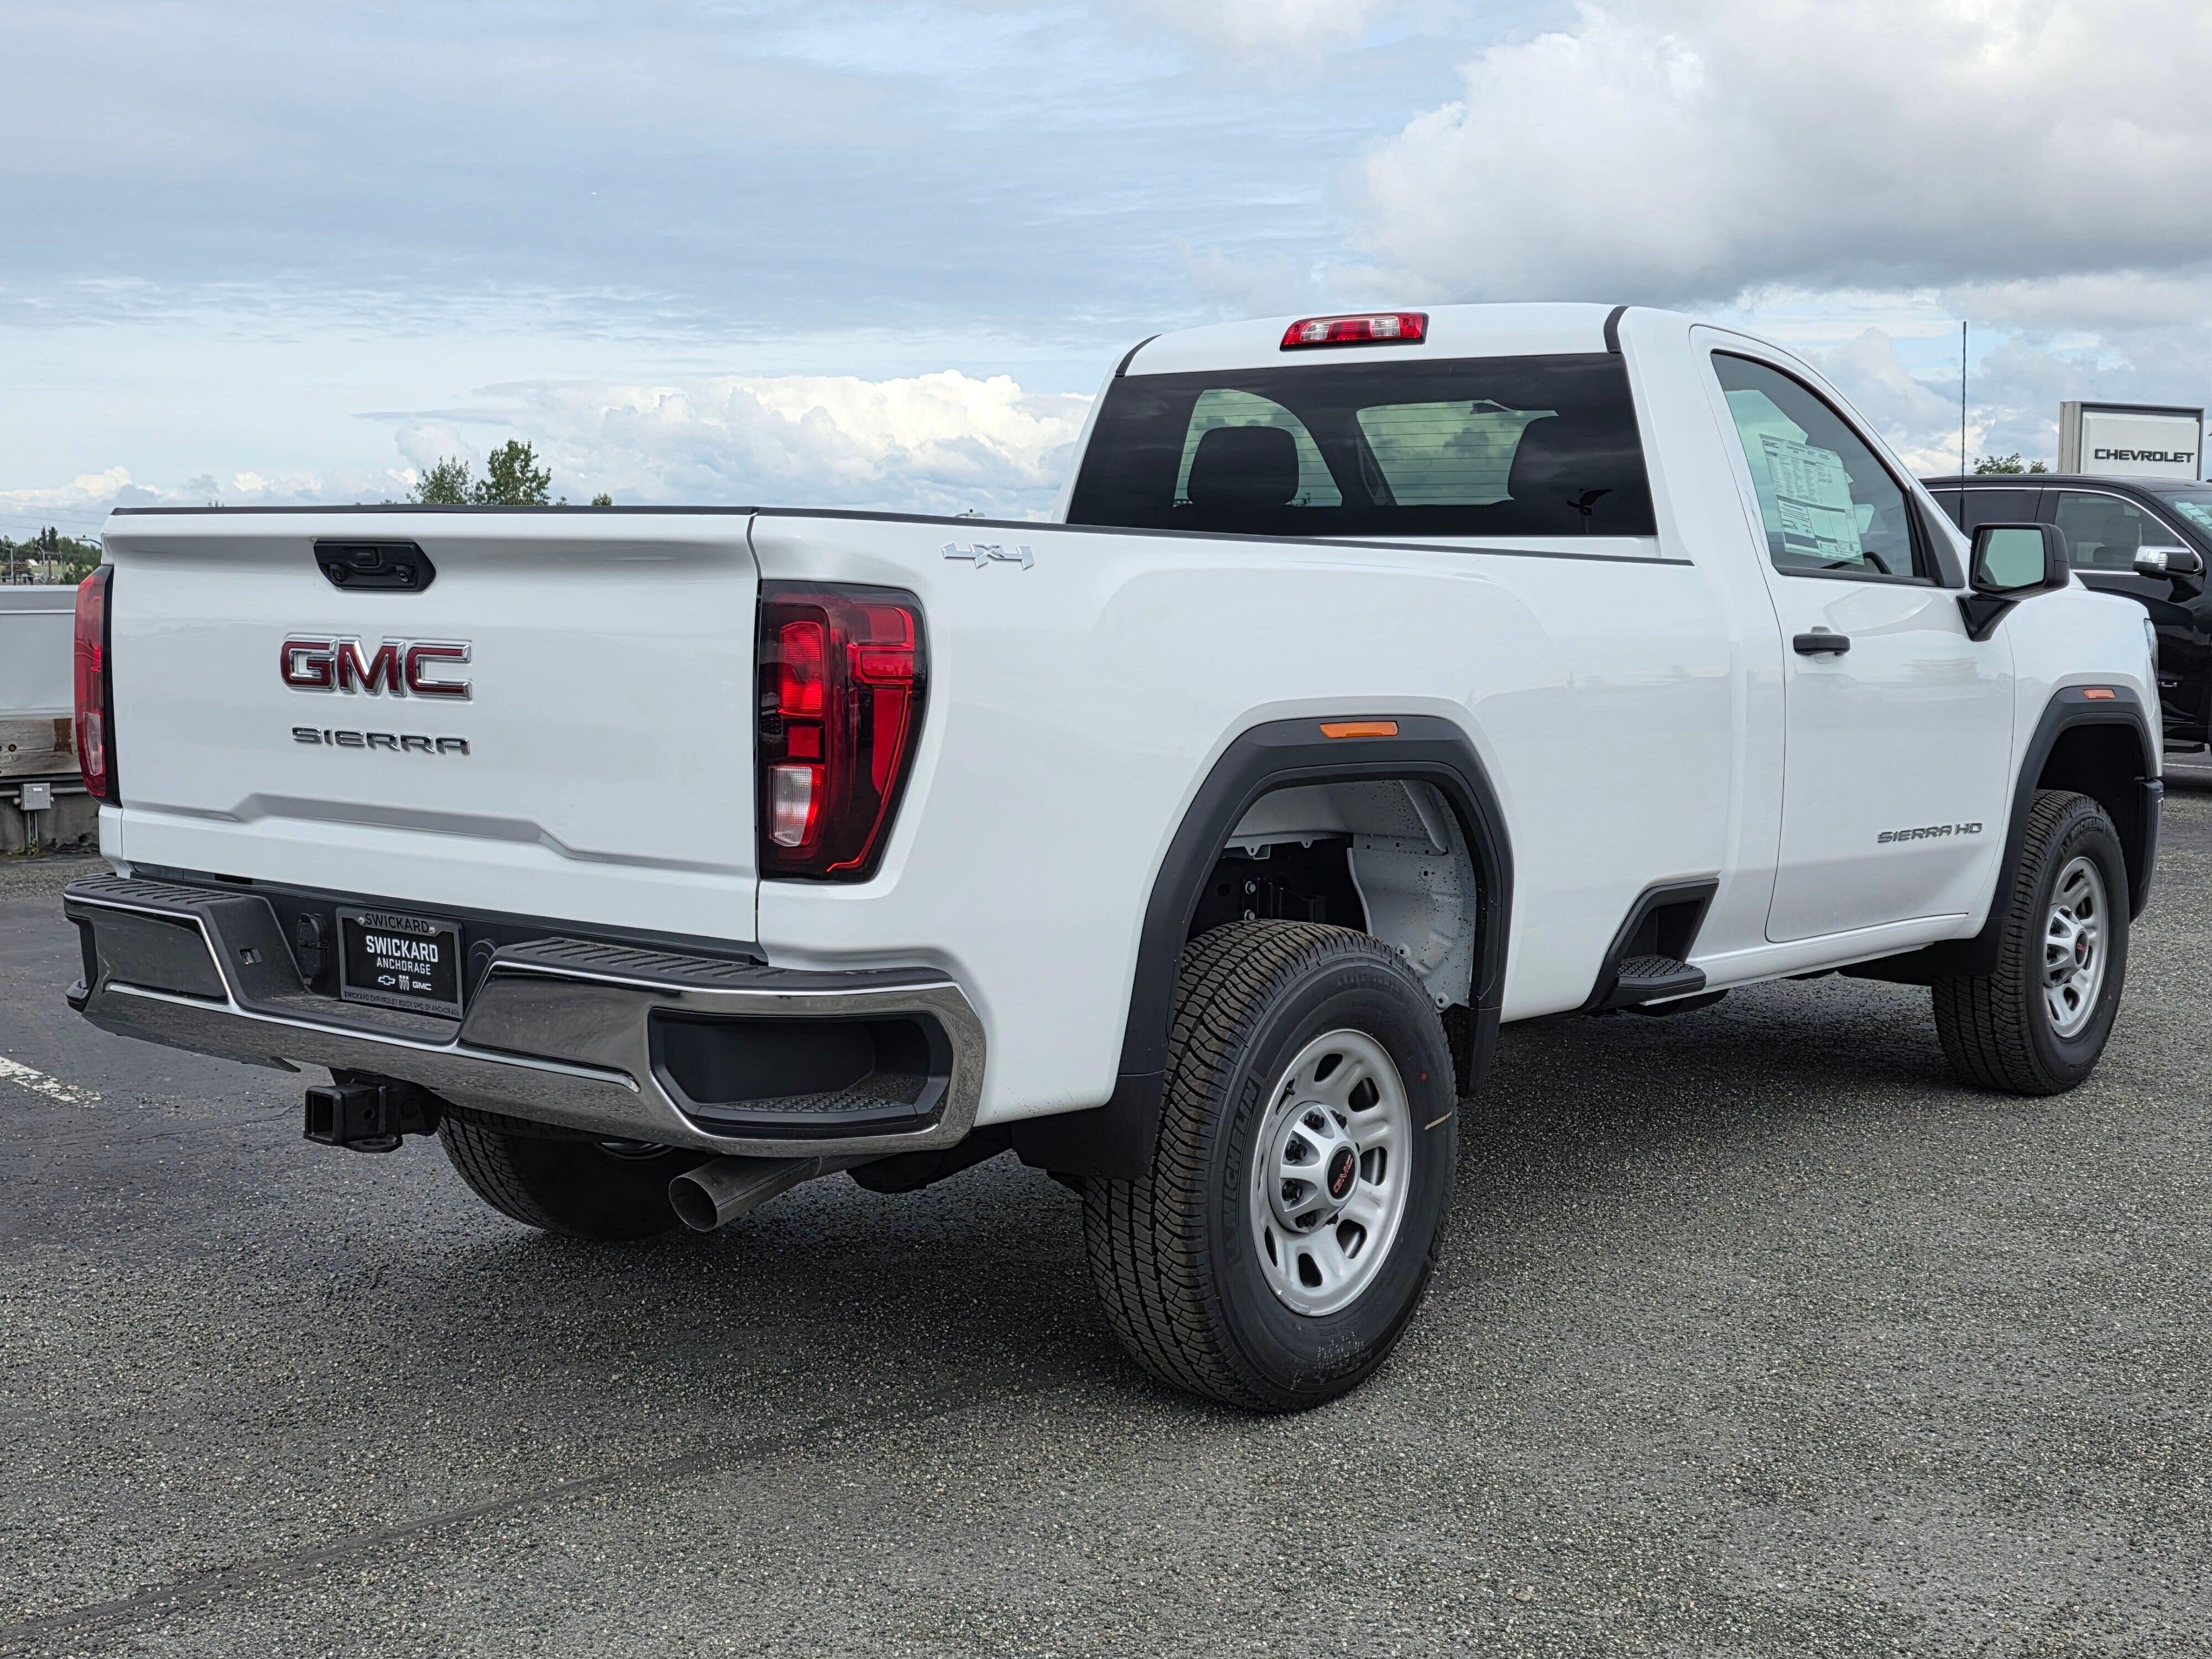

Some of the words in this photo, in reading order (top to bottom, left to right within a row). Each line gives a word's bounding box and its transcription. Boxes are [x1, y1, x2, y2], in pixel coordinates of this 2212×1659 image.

[2095, 448, 2194, 462] CHEVROLET
[280, 637, 472, 700] GMC
[292, 727, 470, 755] SIERRA
[1877, 825, 1952, 843] SIERRA
[1955, 823, 1983, 835] HD
[365, 913, 429, 933] SWICKARD
[366, 935, 439, 963] SWICKARD
[377, 957, 431, 975] ANCHORAGE
[413, 981, 432, 990] GMC
[345, 991, 369, 1001] SWICKARD
[370, 995, 398, 1005] CHEVROLET
[399, 999, 413, 1008] BUICK
[1223, 1076, 1262, 1227] MICHELIN
[1333, 1154, 1353, 1192] GMC
